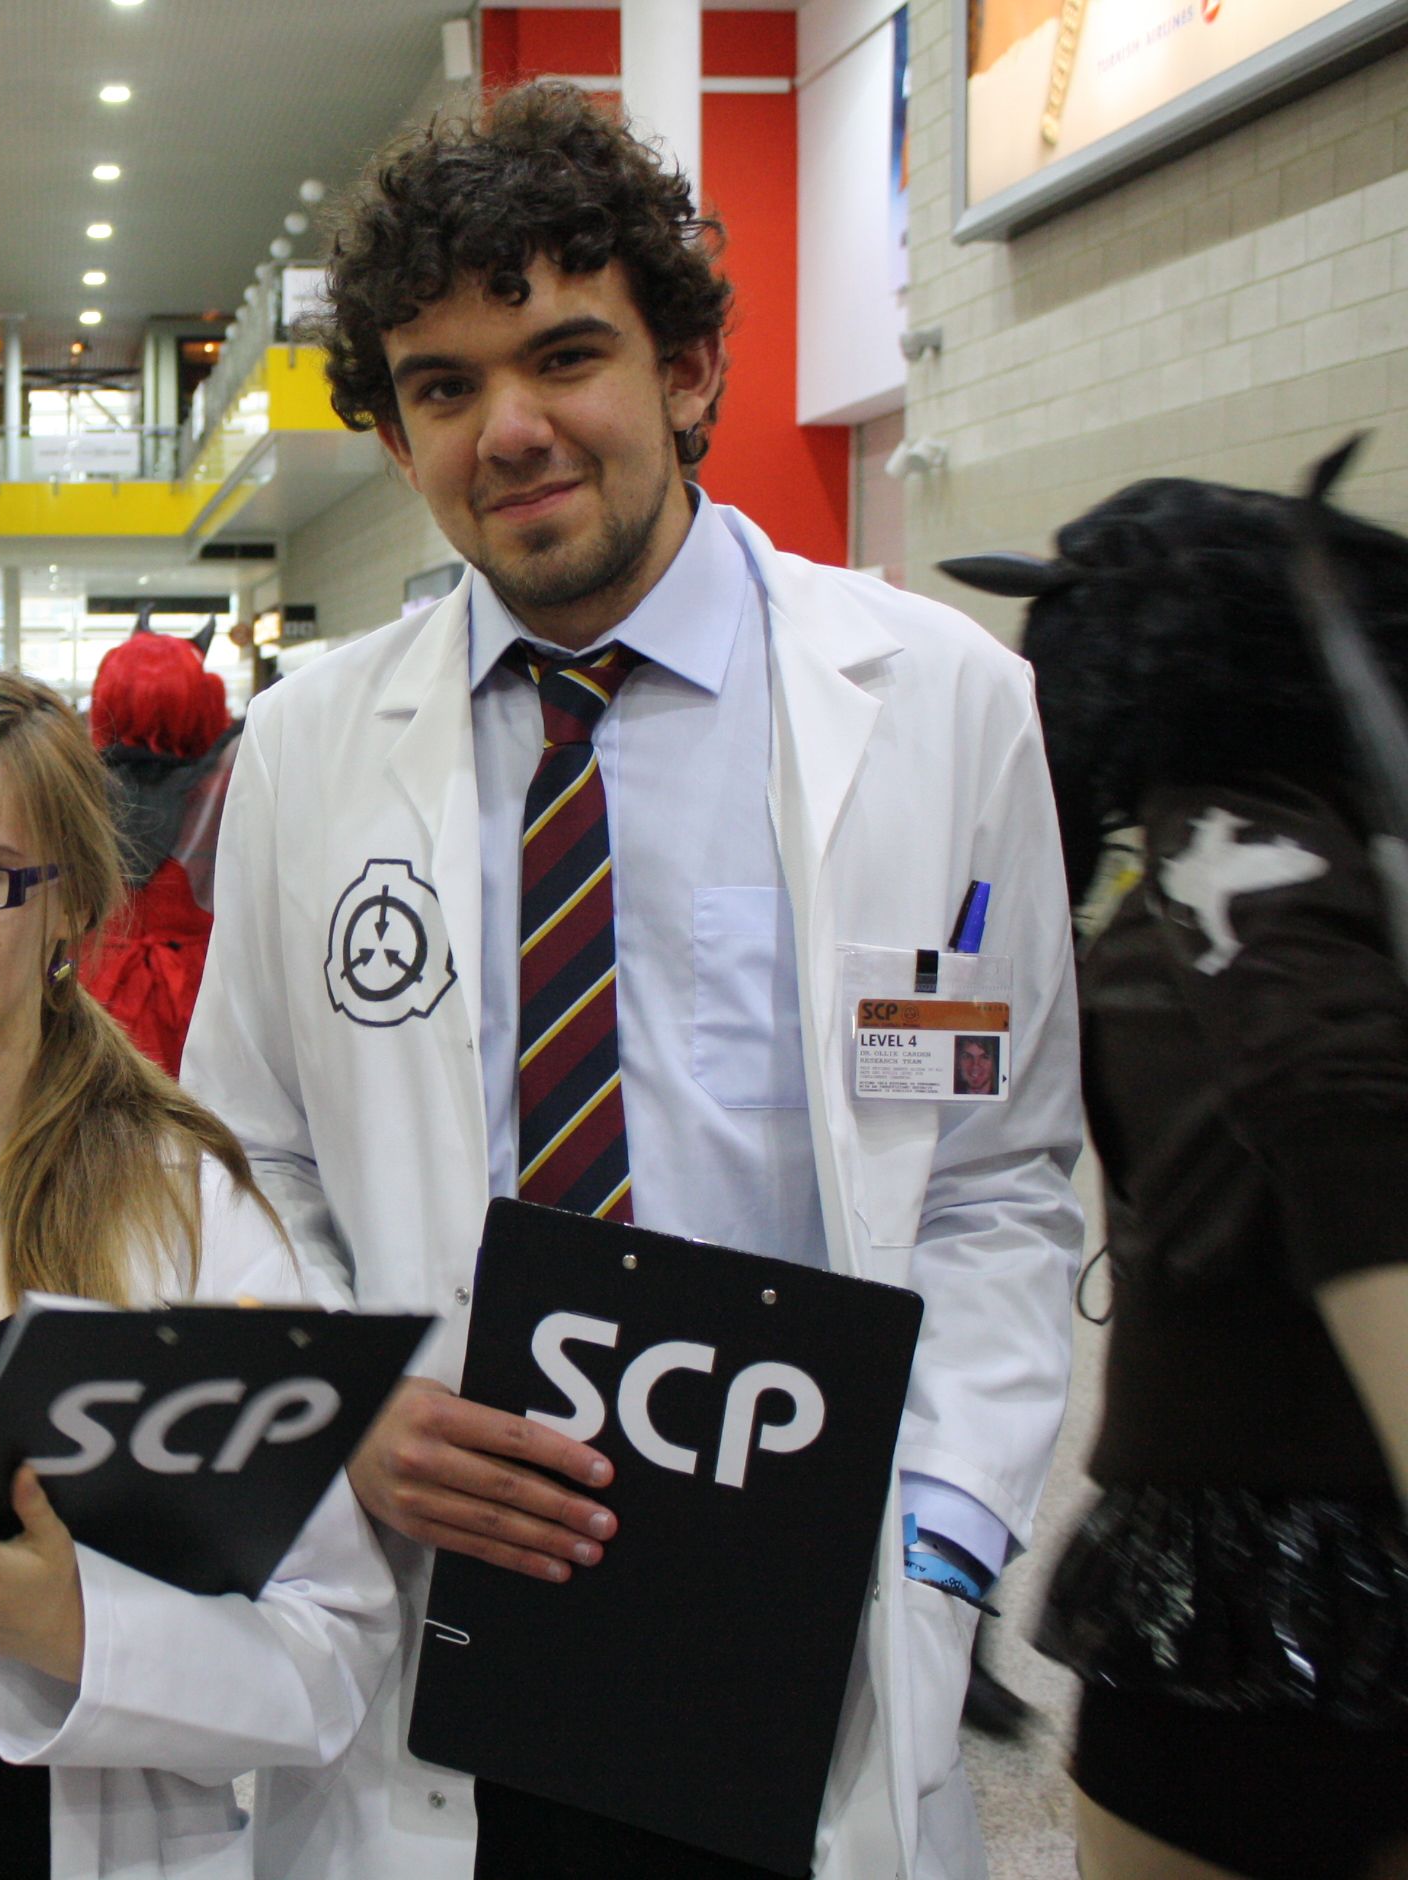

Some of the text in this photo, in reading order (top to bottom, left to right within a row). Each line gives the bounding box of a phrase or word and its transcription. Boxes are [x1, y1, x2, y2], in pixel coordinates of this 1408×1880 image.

[1146, 4, 1193, 45] AIRLINES
[862, 1002, 898, 1021] SCP
[860, 1033, 917, 1047] LEVEL 4
[524, 1309, 826, 1489] SCP
[24, 1376, 341, 1476] SCP
